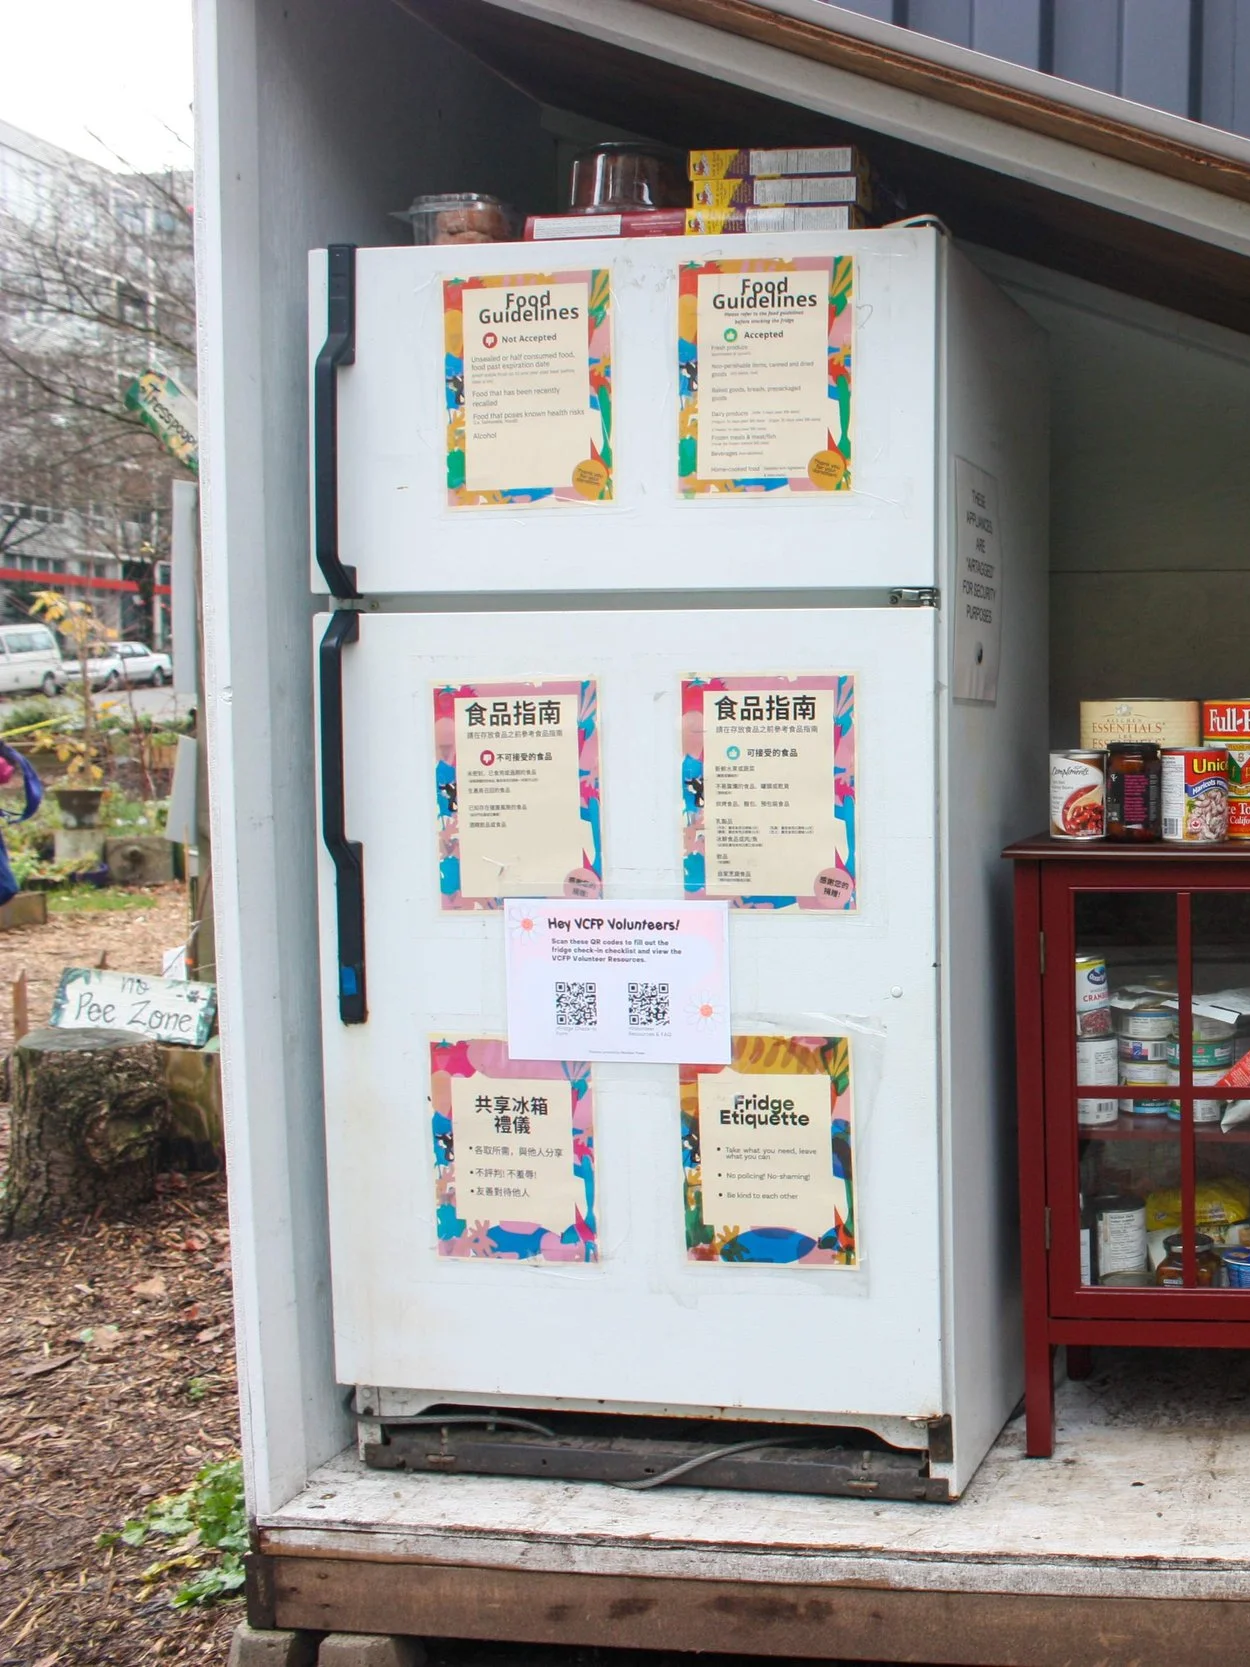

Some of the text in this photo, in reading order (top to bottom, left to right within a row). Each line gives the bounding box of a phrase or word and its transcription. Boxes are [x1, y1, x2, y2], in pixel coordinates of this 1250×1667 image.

[741, 277, 789, 294] Food
[505, 291, 551, 308] Food
[712, 292, 817, 310] Guidelines
[479, 305, 580, 325] Guidelines
[501, 333, 557, 344] Not Accepted
[744, 330, 784, 340] Accepted
[523, 352, 558, 360] consumed
[471, 363, 486, 371] food
[487, 363, 501, 371] past
[502, 361, 535, 370] expiration
[472, 390, 488, 398] Food
[534, 387, 560, 395] recently
[504, 412, 523, 420] poses
[473, 432, 497, 440] Alcohol
[962, 579, 973, 595] FOR
[966, 604, 992, 624] PURPOSES
[465, 700, 561, 727] 食品指南
[714, 695, 817, 721] 食品指南
[1092, 722, 1162, 734] ESSENTIALS
[496, 752, 553, 762] 不可接受的食品
[746, 748, 798, 758] 可接受的食品
[548, 918, 680, 932] Hey VCFP Volunteers!
[121, 977, 149, 995] no
[75, 992, 193, 1033] Pee Zone
[475, 1096, 548, 1115] 共享冰箱
[734, 1095, 795, 1114] Fridge
[494, 1116, 531, 1134] 禮儀
[720, 1110, 810, 1129] Etiquette
[726, 1146, 741, 1154] Take
[762, 1148, 776, 1156] you
[778, 1147, 797, 1155] need,
[799, 1147, 817, 1155] leave
[737, 1172, 765, 1181] policing!
[476, 1187, 529, 1198] 友善對待他人
